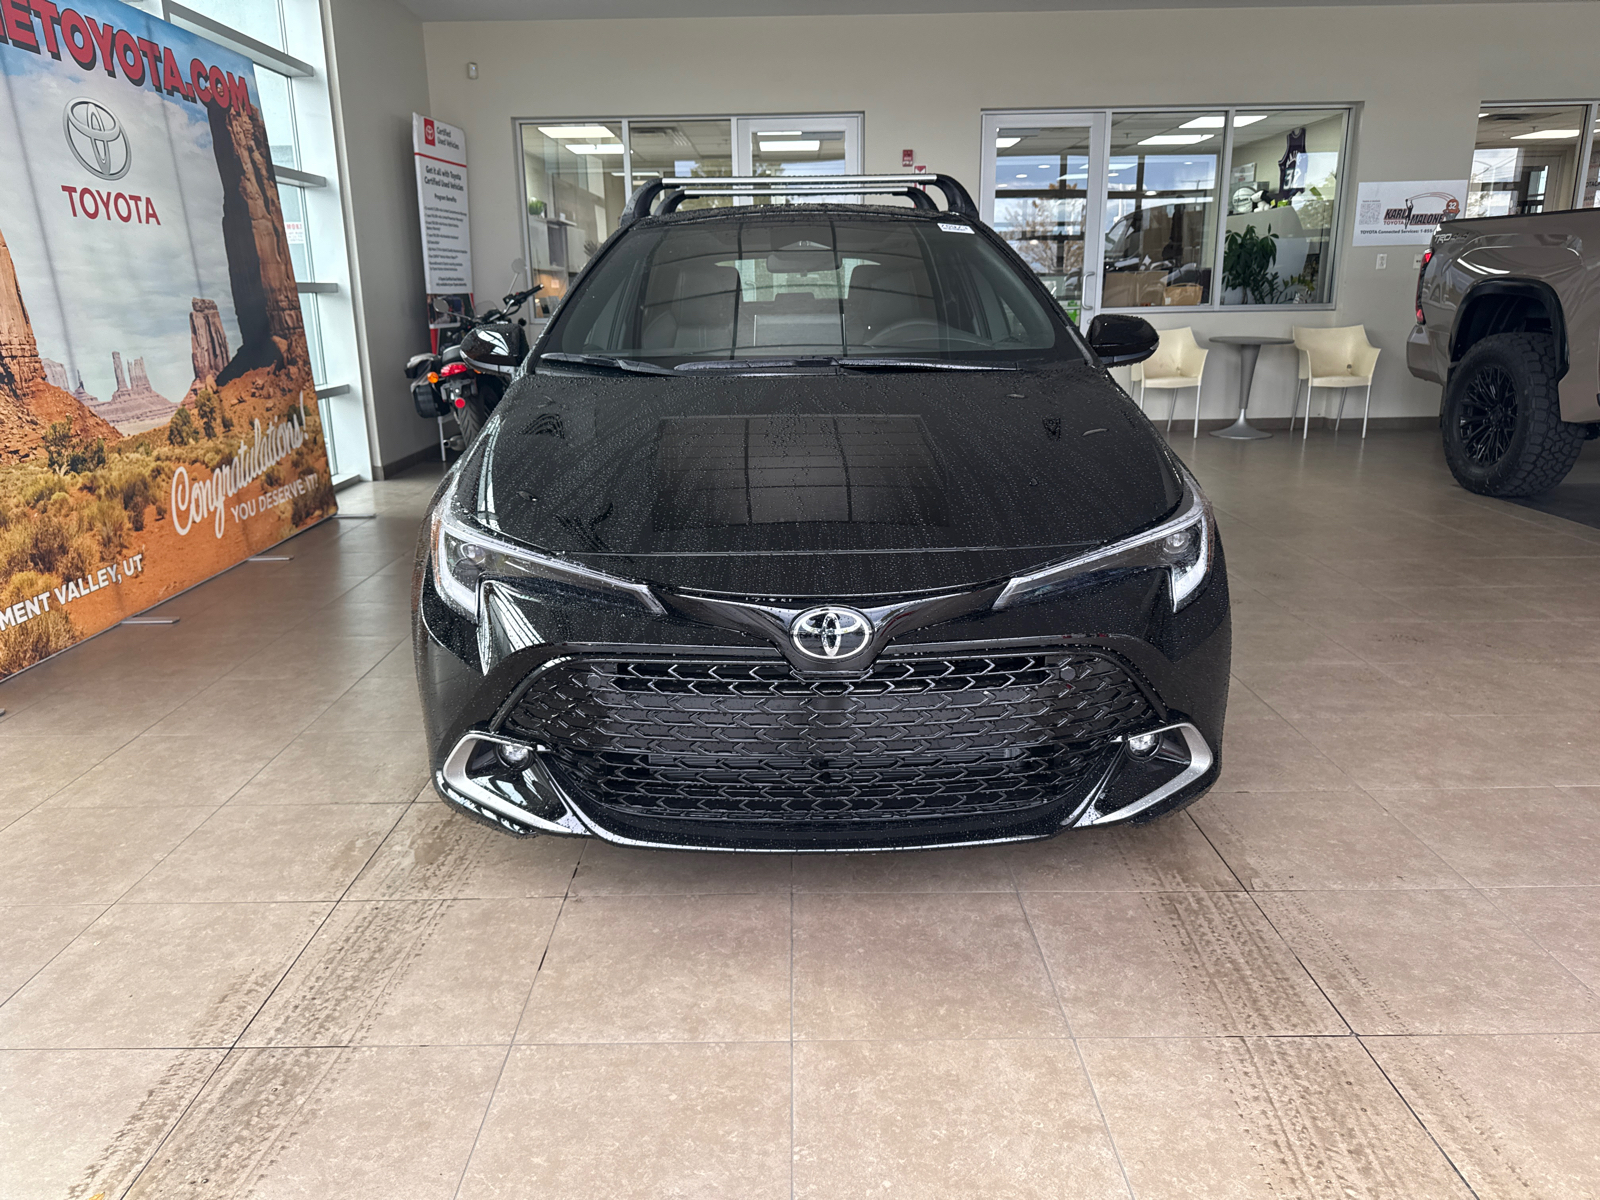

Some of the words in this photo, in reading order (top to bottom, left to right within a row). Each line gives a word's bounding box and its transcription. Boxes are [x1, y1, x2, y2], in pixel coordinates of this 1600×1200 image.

[0, 0, 252, 117] ETOYOTA.COM
[436, 126, 452, 138] Certified
[437, 136, 447, 147] Used
[446, 138, 460, 150] Vehicles
[425, 165, 433, 175] Get
[449, 171, 462, 182] Toyota
[424, 176, 440, 187] Certified
[450, 181, 464, 192] Vehicles
[61, 185, 162, 226] TOYOTA
[1448, 201, 1457, 210] 32
[1384, 208, 1407, 220] KARL
[1409, 213, 1445, 226] MALONE
[1434, 233, 1453, 244] TRD
[171, 390, 309, 539] Congratulations!
[231, 498, 257, 523] YOU
[258, 479, 306, 513] DESERVE
[306, 473, 319, 491] IT!
[0, 592, 50, 631] MENT
[54, 564, 122, 606] VALLEY,
[123, 553, 143, 577] UT
